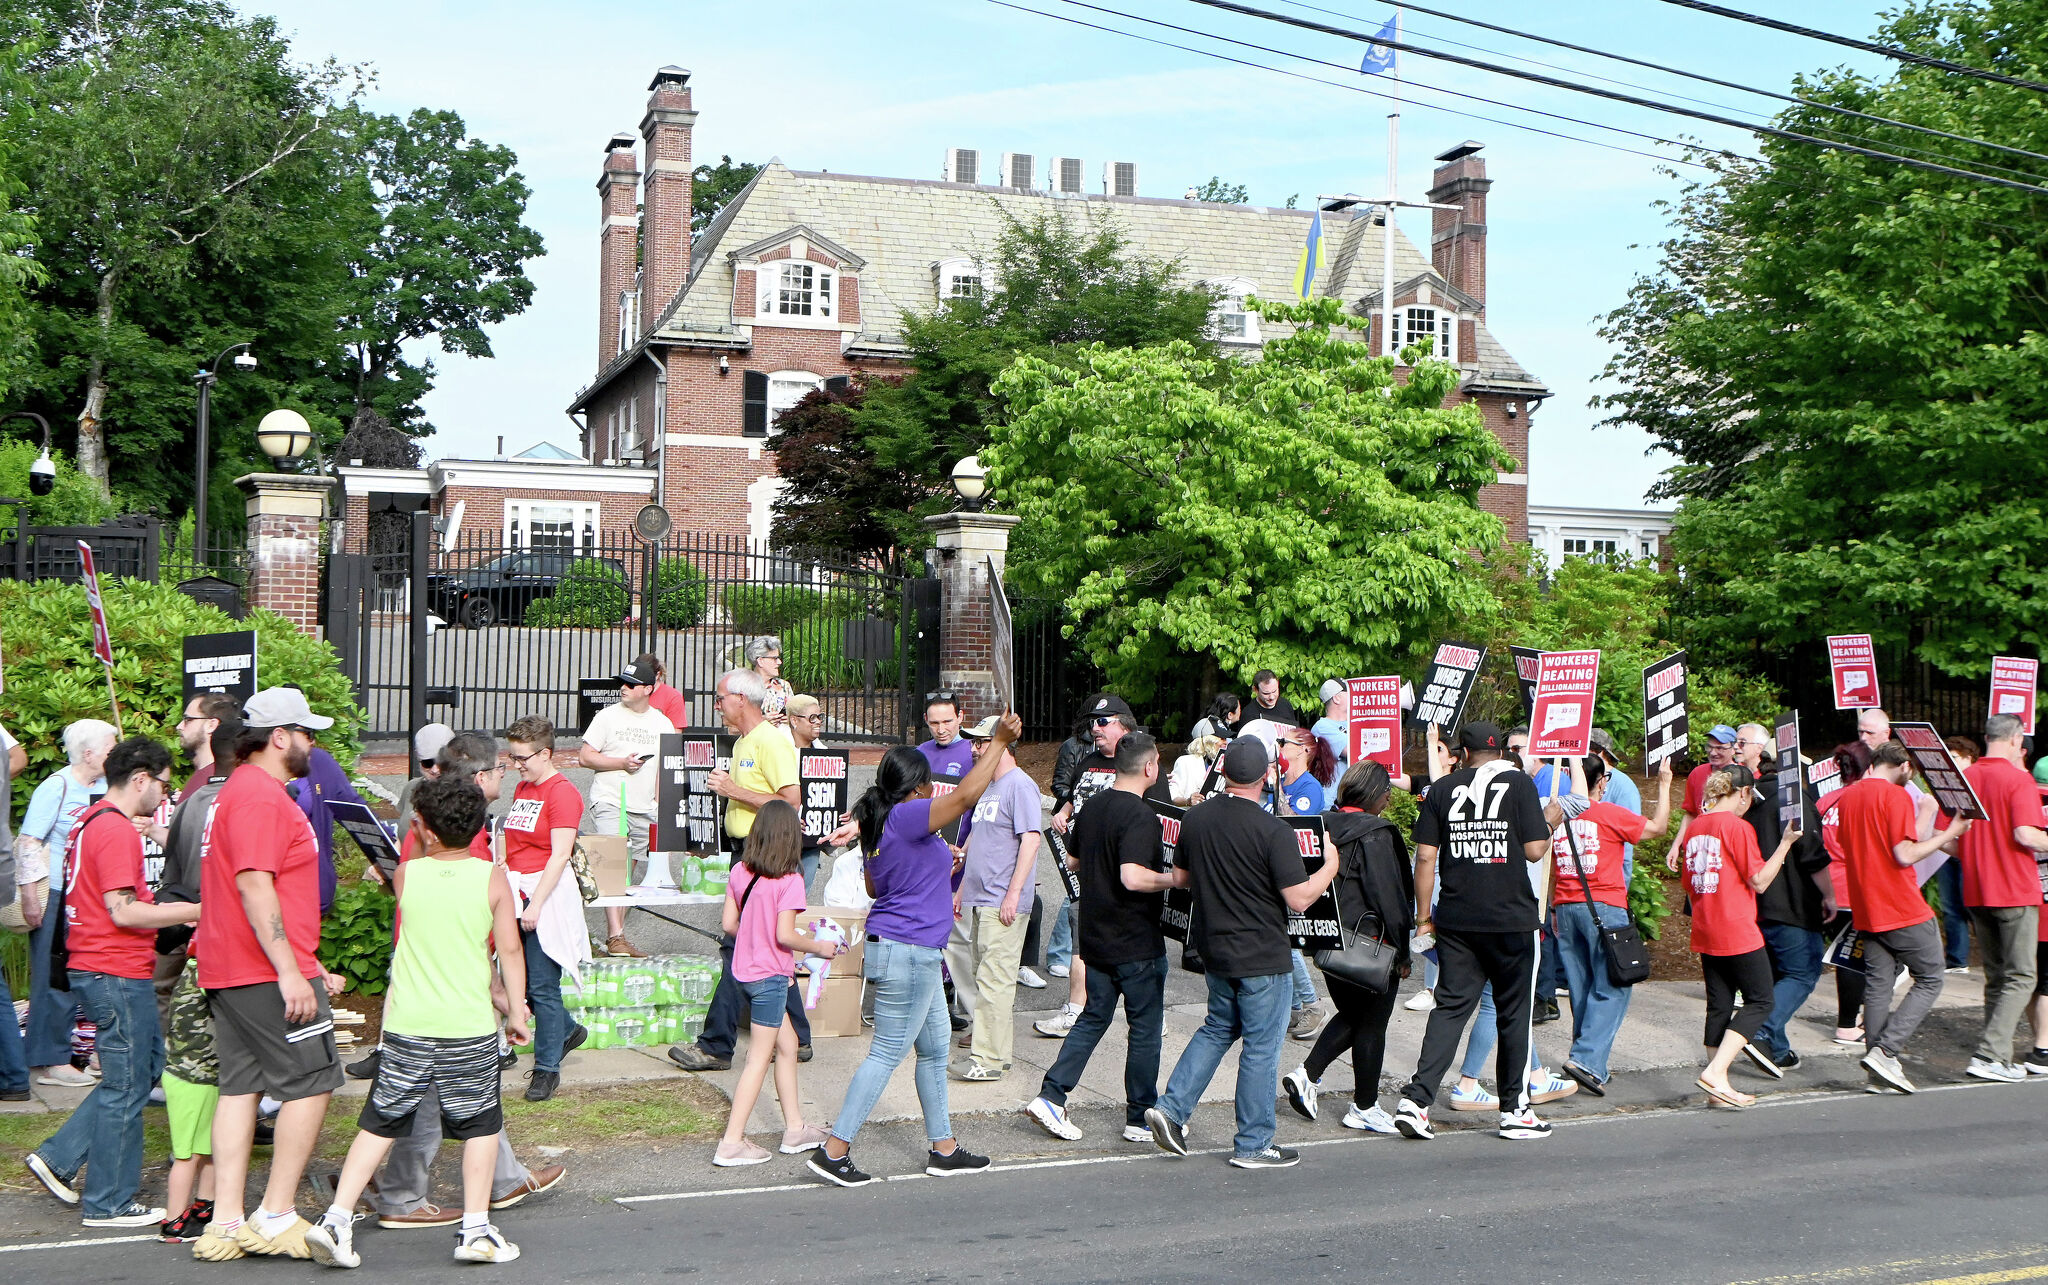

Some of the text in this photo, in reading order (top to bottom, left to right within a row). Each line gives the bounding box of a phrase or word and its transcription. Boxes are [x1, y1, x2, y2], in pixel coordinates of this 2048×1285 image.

[1831, 638, 1868, 646] WORKERS
[1434, 644, 1480, 670] LAMONT:
[1832, 647, 1869, 656] BEATING
[1545, 655, 1595, 666] WORKERS
[1433, 667, 1466, 688] WHICH
[1542, 669, 1593, 681] BEATING
[1647, 662, 1684, 700] LAMONT:
[1351, 681, 1397, 692] WORKERS
[1541, 683, 1592, 691] BILLIONAIRES!
[1352, 694, 1397, 706] BEATING
[1423, 684, 1461, 707] SIDE ARE
[1352, 708, 1397, 716] BILLIONAIRES!
[1416, 702, 1454, 725] YOU ON?
[1537, 740, 1581, 748] UNITEHERE!
[684, 741, 714, 767] LAMONT:
[802, 756, 846, 778] LAMONT:
[807, 782, 836, 808] SIGN
[512, 801, 542, 814] UNITE
[689, 795, 701, 817] SIDE
[702, 796, 713, 818] ARE
[690, 819, 714, 843] YOU ON?
[1449, 821, 1508, 831] THE FIGHTING
[1450, 831, 1507, 841] HOSPITALITY
[1450, 840, 1507, 858] UNION
[1314, 920, 1339, 937] CEOS
